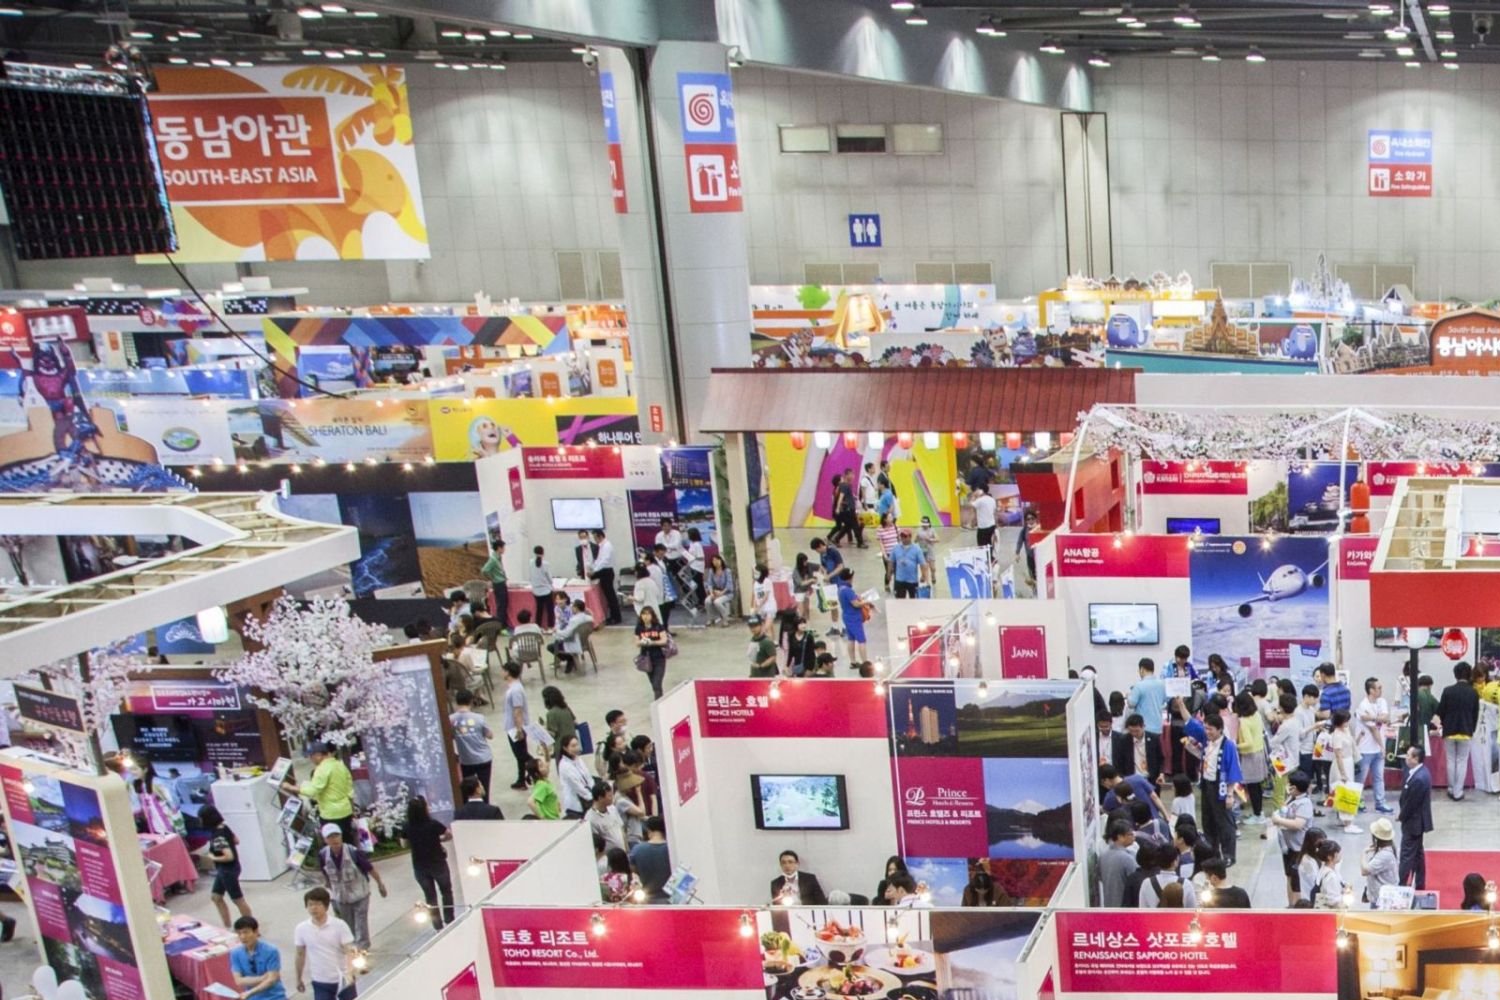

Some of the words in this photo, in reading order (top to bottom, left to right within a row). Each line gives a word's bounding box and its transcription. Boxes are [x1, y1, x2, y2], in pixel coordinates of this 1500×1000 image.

[156, 114, 312, 161] 동남아관
[163, 168, 273, 186] SOUTH-EAST
[278, 167, 318, 183] ASIA
[308, 425, 364, 437] SHERATON
[365, 425, 388, 436] BALI
[597, 431, 633, 445] 하나투어
[1063, 548, 1100, 558] ANA항공
[1346, 551, 1375, 561] 카가와
[1011, 646, 1039, 659] JAPAN
[706, 695, 741, 708] 프린스
[745, 695, 769, 708] 호텔
[708, 709, 730, 717] PRINCE
[731, 709, 755, 717] HOTELS
[936, 787, 968, 798] Prince
[906, 809, 928, 818] 프린스
[929, 809, 950, 818] 호텔즈
[960, 809, 982, 818] 리조트
[501, 929, 534, 946] 토호
[539, 929, 589, 946] 리조트
[1072, 932, 1140, 949] 르네상스
[1146, 932, 1198, 949] 삿포로
[1204, 932, 1238, 949] 호텔
[503, 948, 530, 958] TOHO
[531, 948, 563, 958] RESORT
[565, 948, 583, 960] Co.,
[584, 948, 599, 958] Ltd.
[1073, 951, 1134, 960] RENAISSANCE
[1136, 951, 1178, 960] SAPPORO
[1179, 951, 1209, 960] HOTEL
